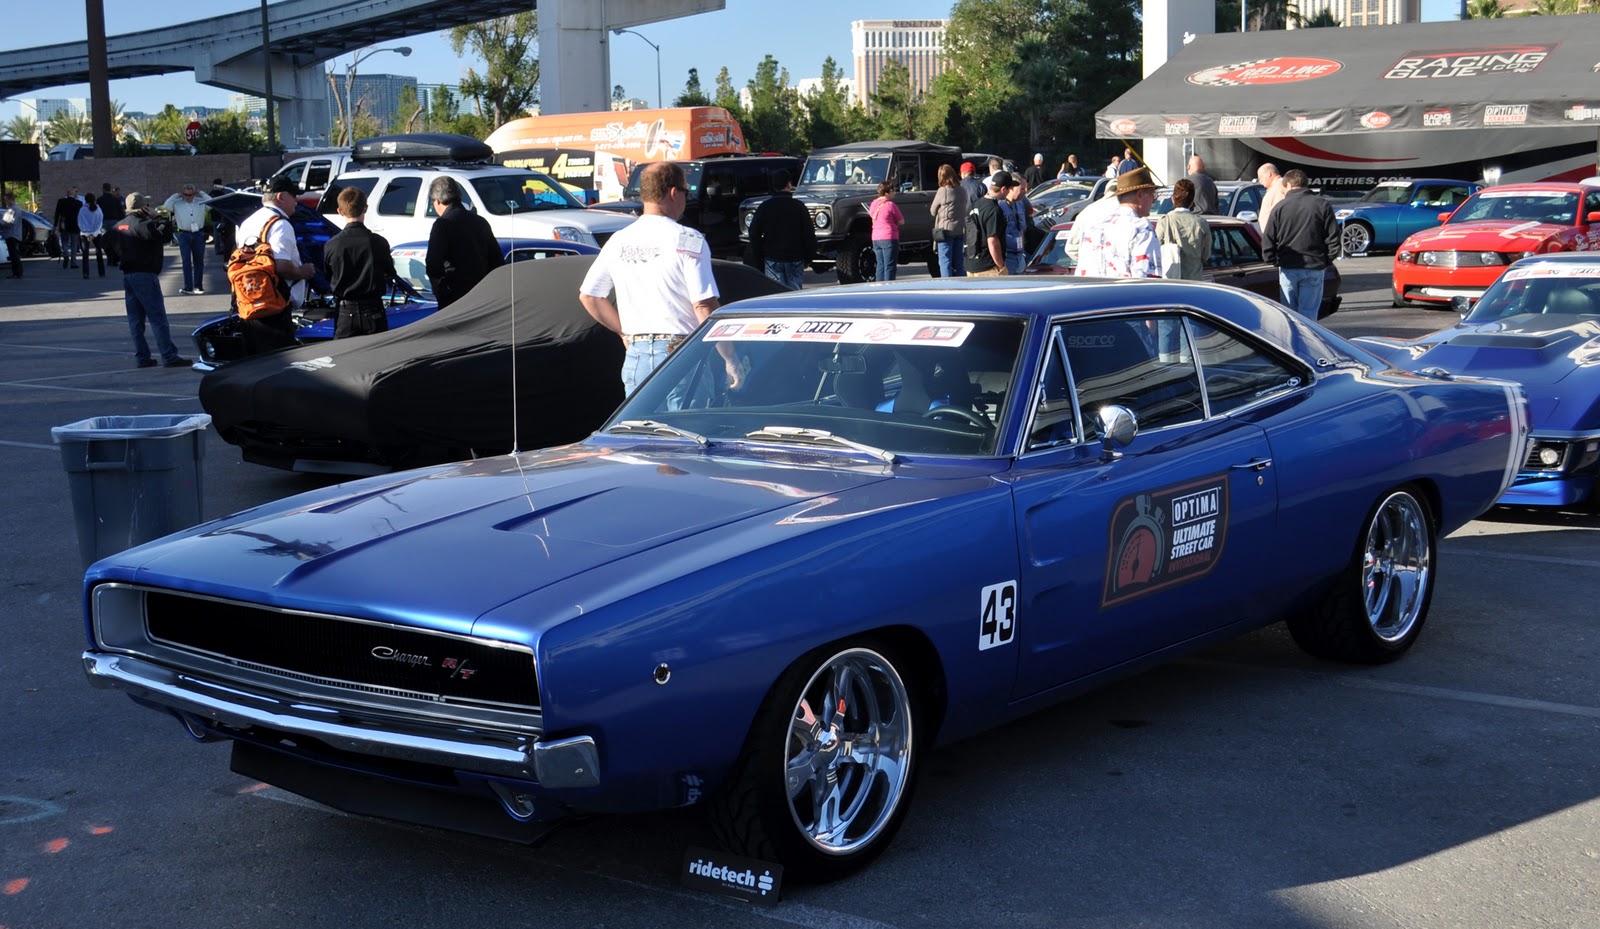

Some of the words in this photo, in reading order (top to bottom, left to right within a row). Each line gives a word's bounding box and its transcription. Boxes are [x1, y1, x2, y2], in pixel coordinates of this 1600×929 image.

[1393, 52, 1548, 69] RACING
[1236, 66, 1278, 78] RED
[1280, 64, 1333, 75] LINE
[1486, 105, 1527, 116] OPTIMA
[1221, 116, 1257, 126] OPTIMA
[187, 129, 200, 140] STO
[1067, 334, 1115, 348] sparco
[1173, 493, 1217, 522] OPTIMA
[1172, 520, 1216, 546] ULTIMATE
[1170, 541, 1198, 560] STREET
[1197, 536, 1214, 552] CAR
[982, 585, 1015, 645] 43
[371, 646, 432, 668] Charger
[441, 657, 476, 680] R/T
[688, 859, 756, 887] ridetech
